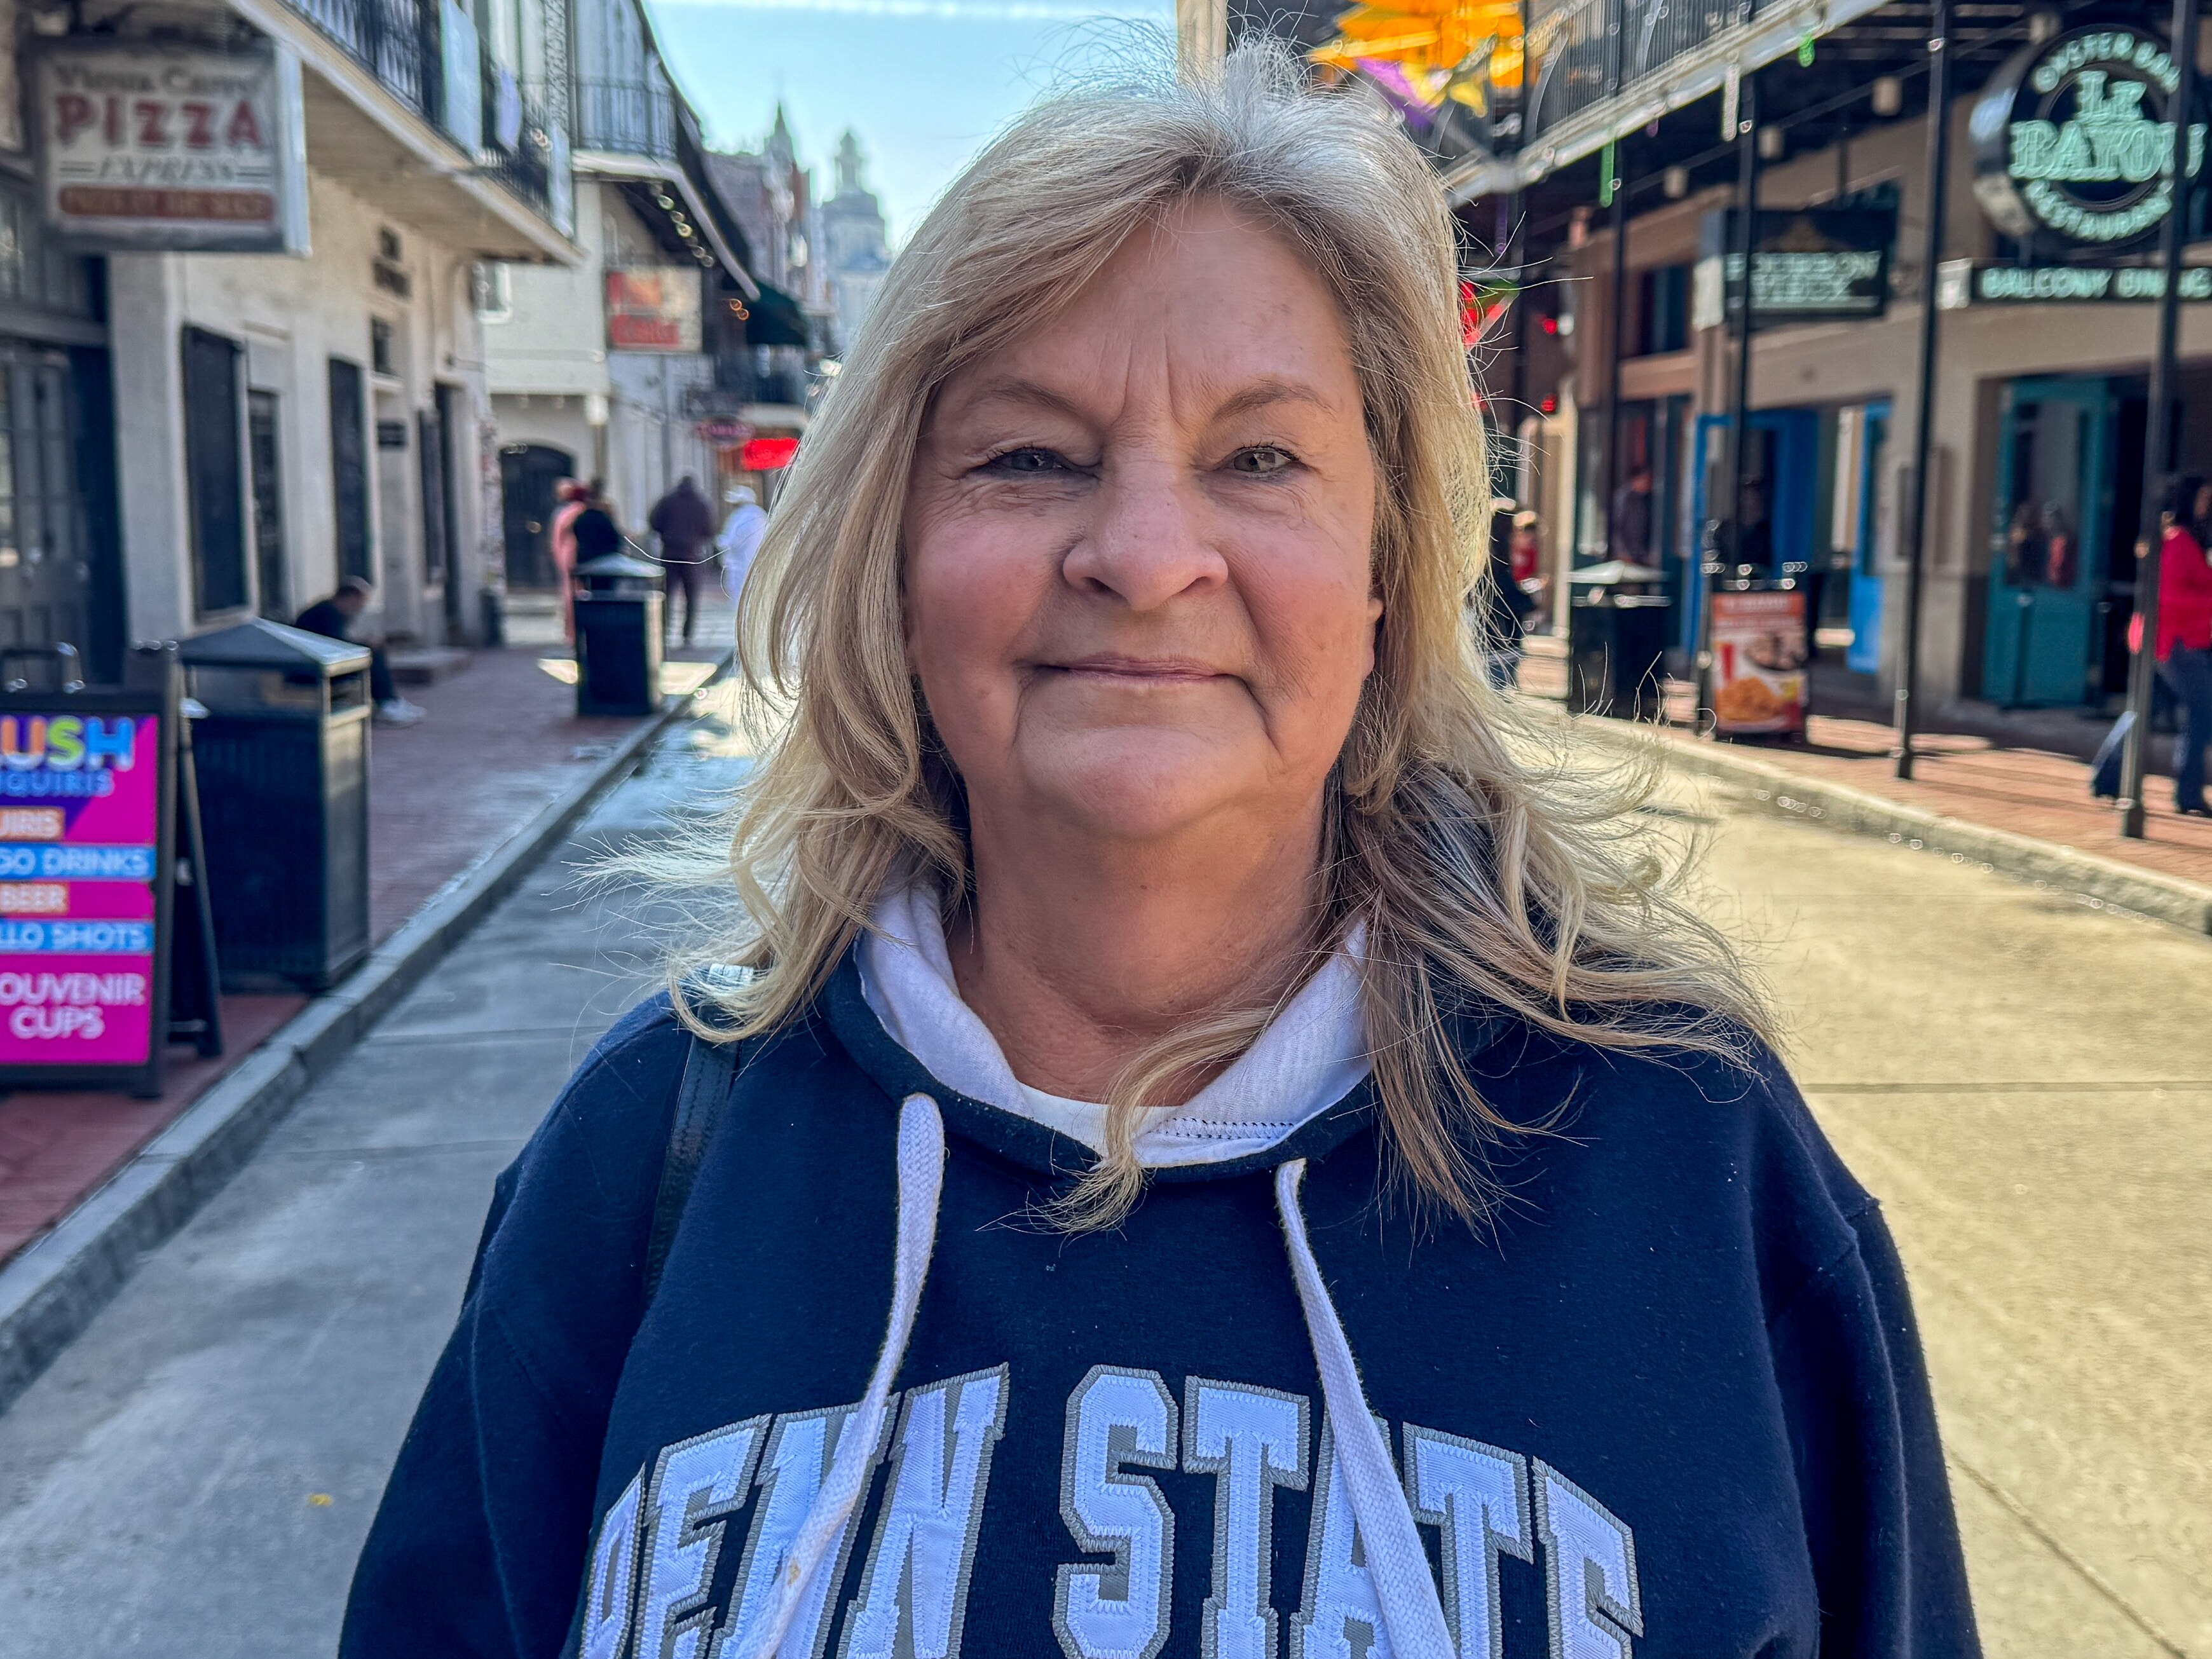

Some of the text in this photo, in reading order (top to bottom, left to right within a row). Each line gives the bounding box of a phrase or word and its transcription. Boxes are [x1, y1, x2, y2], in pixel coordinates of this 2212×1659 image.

[55, 93, 266, 151] PIZZA
[2008, 120, 2209, 183] BAYOU
[1982, 267, 2212, 299] BALCONY DINNG
[0, 715, 136, 772] USH
[42, 848, 150, 877] DRINKS
[0, 884, 67, 913] BEER
[51, 924, 148, 952] SHOTS
[8, 1005, 106, 1039] CUPS
[577, 1362, 1644, 1659] PENN STATE
